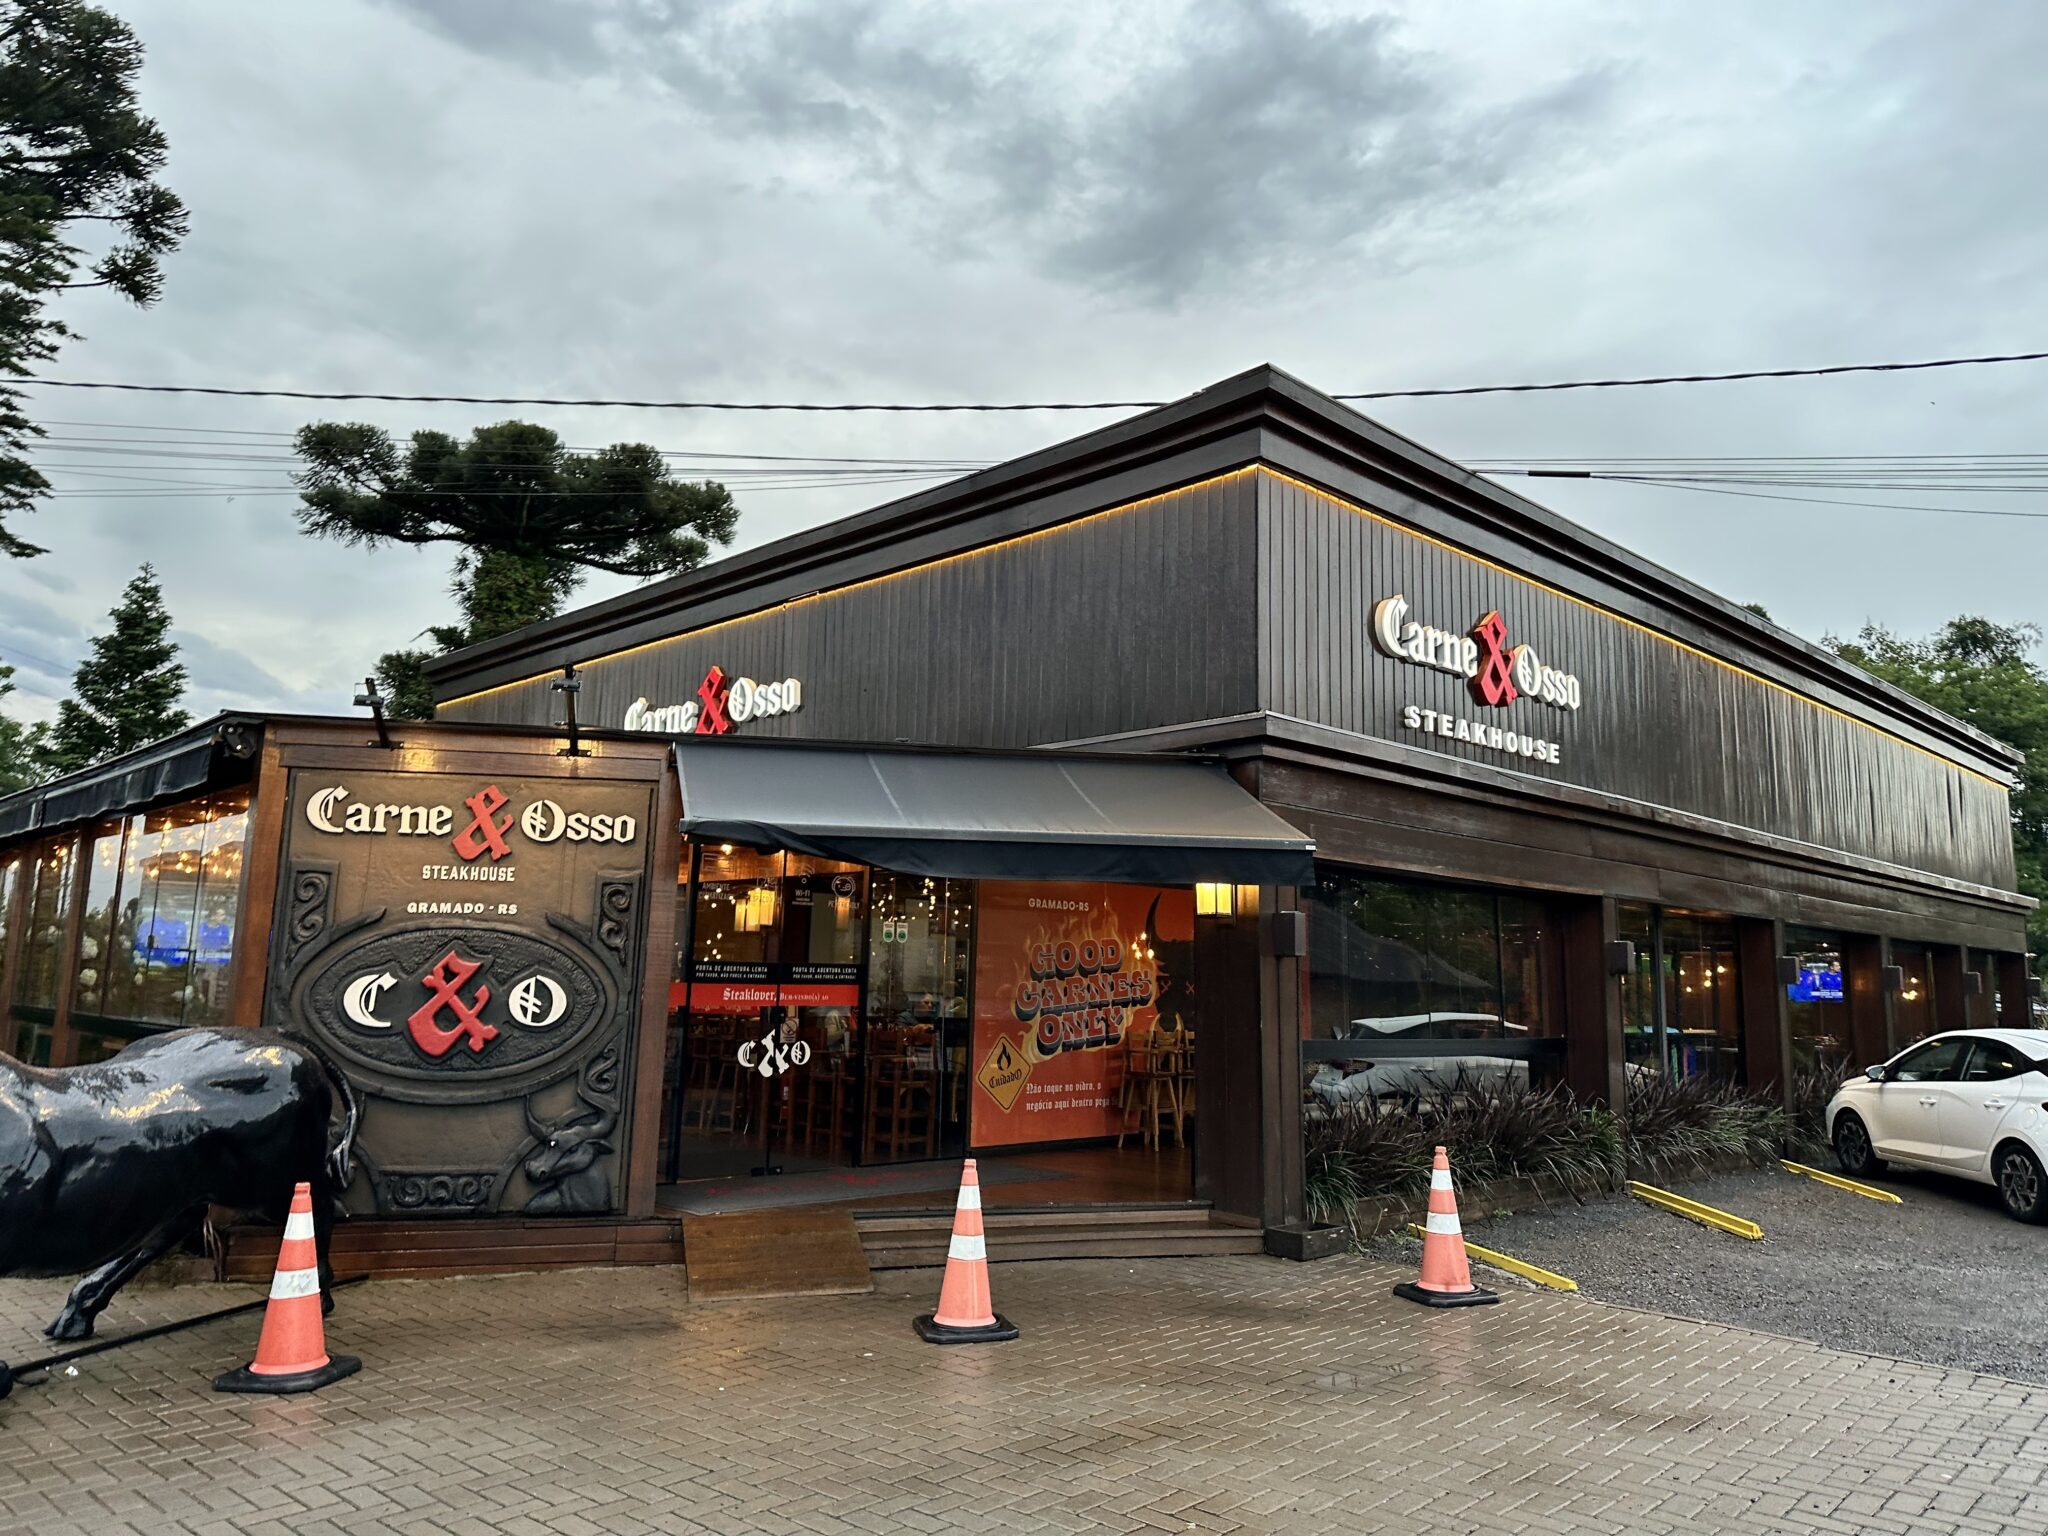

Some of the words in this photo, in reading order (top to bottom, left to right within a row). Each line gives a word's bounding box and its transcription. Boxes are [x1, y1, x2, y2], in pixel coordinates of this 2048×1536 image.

[1375, 594, 1478, 678] Carne
[1473, 609, 1518, 707] &
[1512, 644, 1580, 711] Osso
[624, 697, 698, 732] Carne
[695, 665, 730, 734] &
[728, 677, 801, 722] Osso
[1404, 705, 1560, 764] STEAKHOUSE
[306, 785, 453, 837] Carne
[450, 784, 515, 861] &
[520, 799, 636, 844] Osso
[422, 865, 515, 881] STEAKHOUSE
[407, 902, 484, 914] GRAMADO
[497, 904, 518, 915] RS
[1030, 938, 1123, 981] GOOD
[723, 987, 777, 1001] Steaklover,
[1015, 969, 1152, 1020] CARNES
[1037, 1006, 1124, 1055] ONLY
[1026, 1100, 1052, 1112] negócio
[1054, 1100, 1070, 1112] aqui
[1071, 1098, 1093, 1108] dentro
[1043, 1083, 1063, 1096] toque
[1065, 1084, 1073, 1092] no
